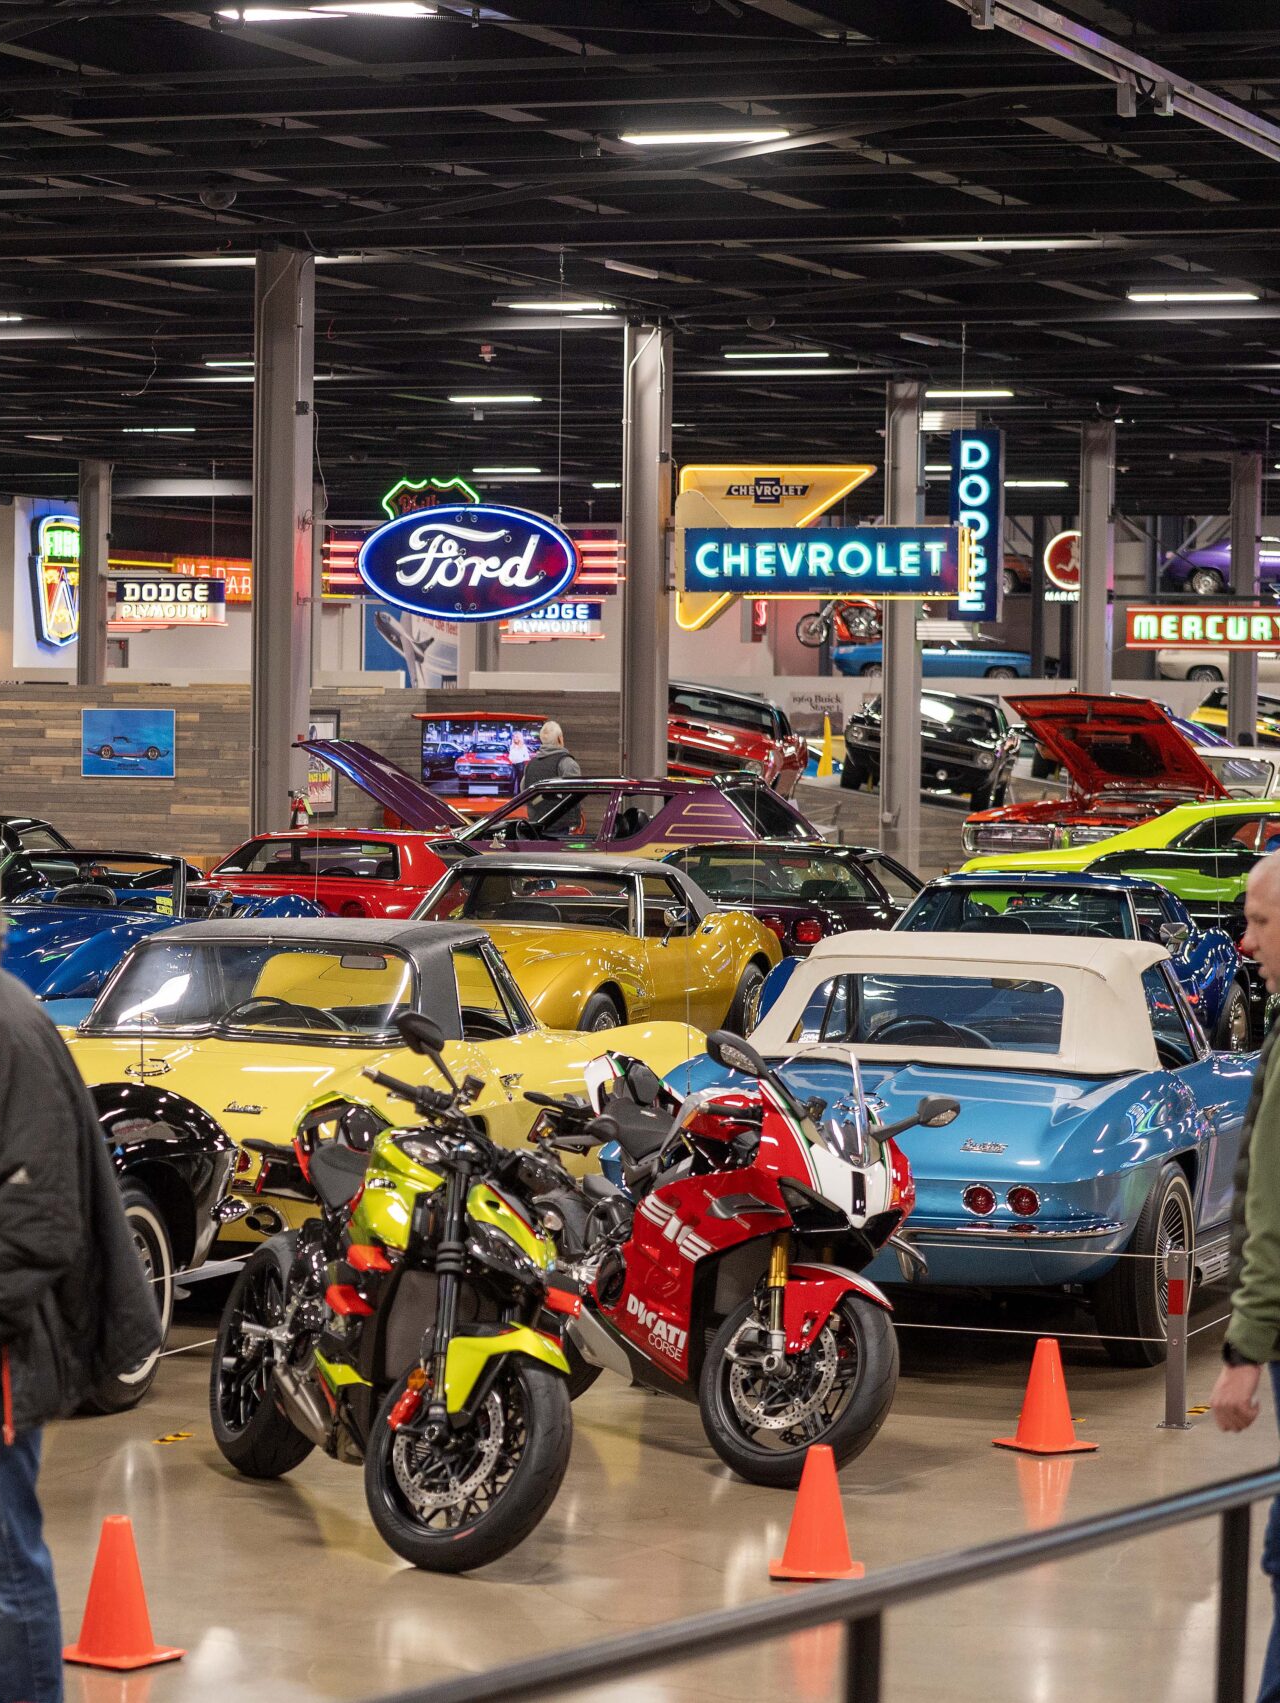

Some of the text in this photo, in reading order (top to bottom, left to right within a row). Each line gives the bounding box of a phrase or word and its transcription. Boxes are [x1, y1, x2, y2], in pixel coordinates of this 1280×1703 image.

[730, 485, 804, 497] CHEVROLET
[396, 523, 543, 590] Ford
[695, 541, 948, 577] CHEVROLET
[123, 583, 209, 602] DODGE
[1045, 591, 1080, 602] MARAT
[122, 603, 208, 619] PLYMOUTH
[523, 603, 589, 620] ODGE
[626, 1293, 688, 1349] DUCATI
[647, 1332, 683, 1361] CORSE
